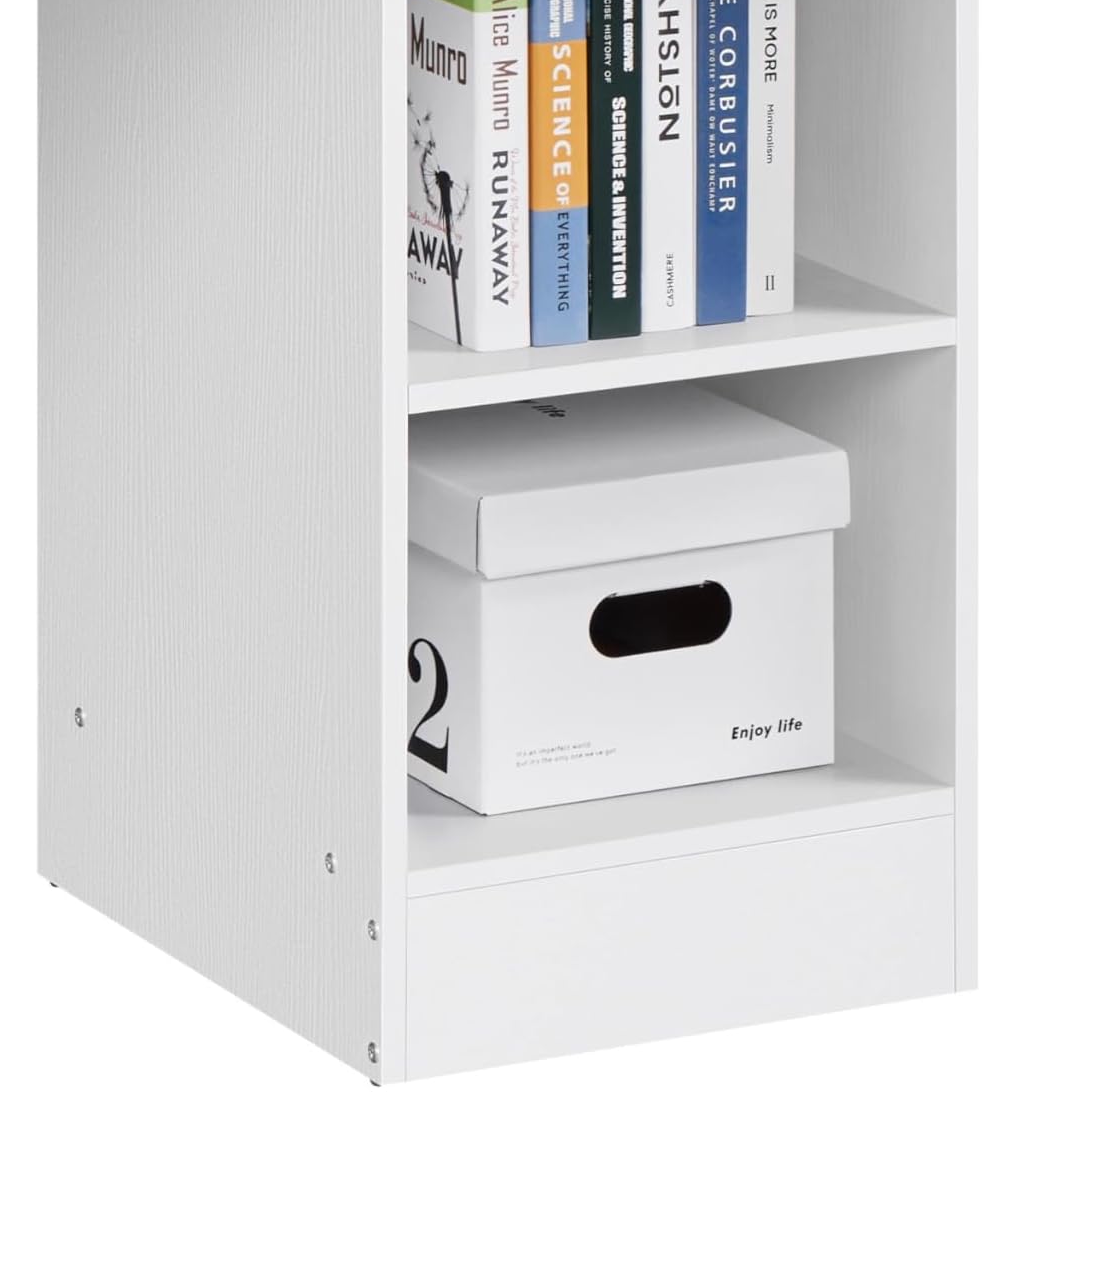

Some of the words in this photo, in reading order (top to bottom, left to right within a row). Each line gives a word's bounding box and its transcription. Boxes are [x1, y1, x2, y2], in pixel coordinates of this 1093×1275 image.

[764, 3, 778, 21] IS
[411, 12, 467, 85] Munro
[603, 24, 612, 66] HISTORY
[763, 26, 778, 83] MORE
[492, 60, 519, 131] Munro
[604, 70, 612, 84] OF
[553, 44, 571, 177] SCIENCE
[718, 25, 737, 213] CORBUSIER
[556, 182, 570, 205] OF
[407, 226, 463, 281] AWAY
[492, 150, 509, 306] RUNAWAY
[557, 211, 570, 312] EVERYTHING
[666, 253, 675, 308] CASHMERE
[407, 638, 449, 774] 2
[731, 724, 773, 741] Enjoy
[777, 717, 803, 733] life
